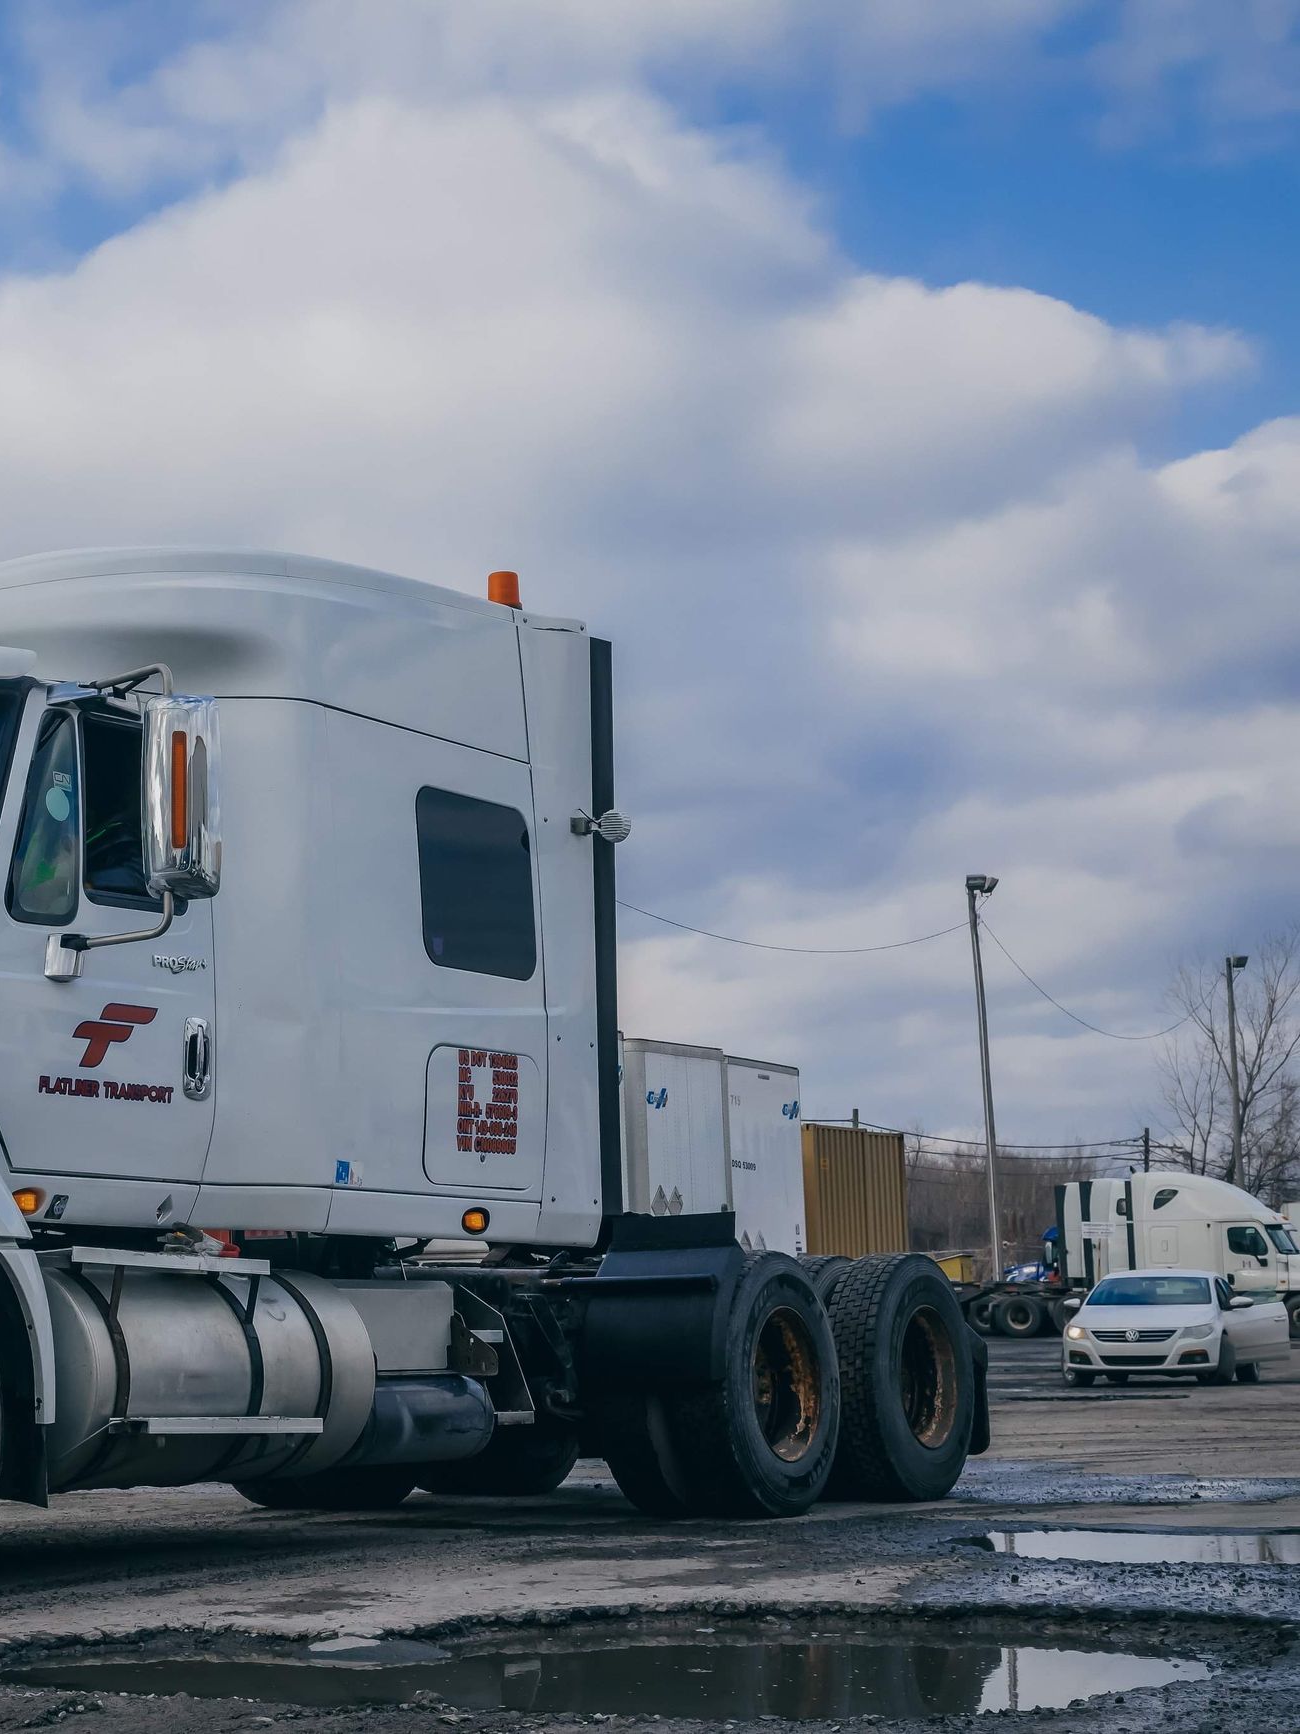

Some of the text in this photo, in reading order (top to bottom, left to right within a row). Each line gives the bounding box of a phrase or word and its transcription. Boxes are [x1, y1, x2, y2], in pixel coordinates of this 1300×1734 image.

[471, 1051, 488, 1069] DOT
[458, 1066, 472, 1084] MC
[38, 1075, 174, 1104] FLATLINER TRANSPORT
[456, 1118, 475, 1135] ONT
[456, 1135, 473, 1152] VIN
